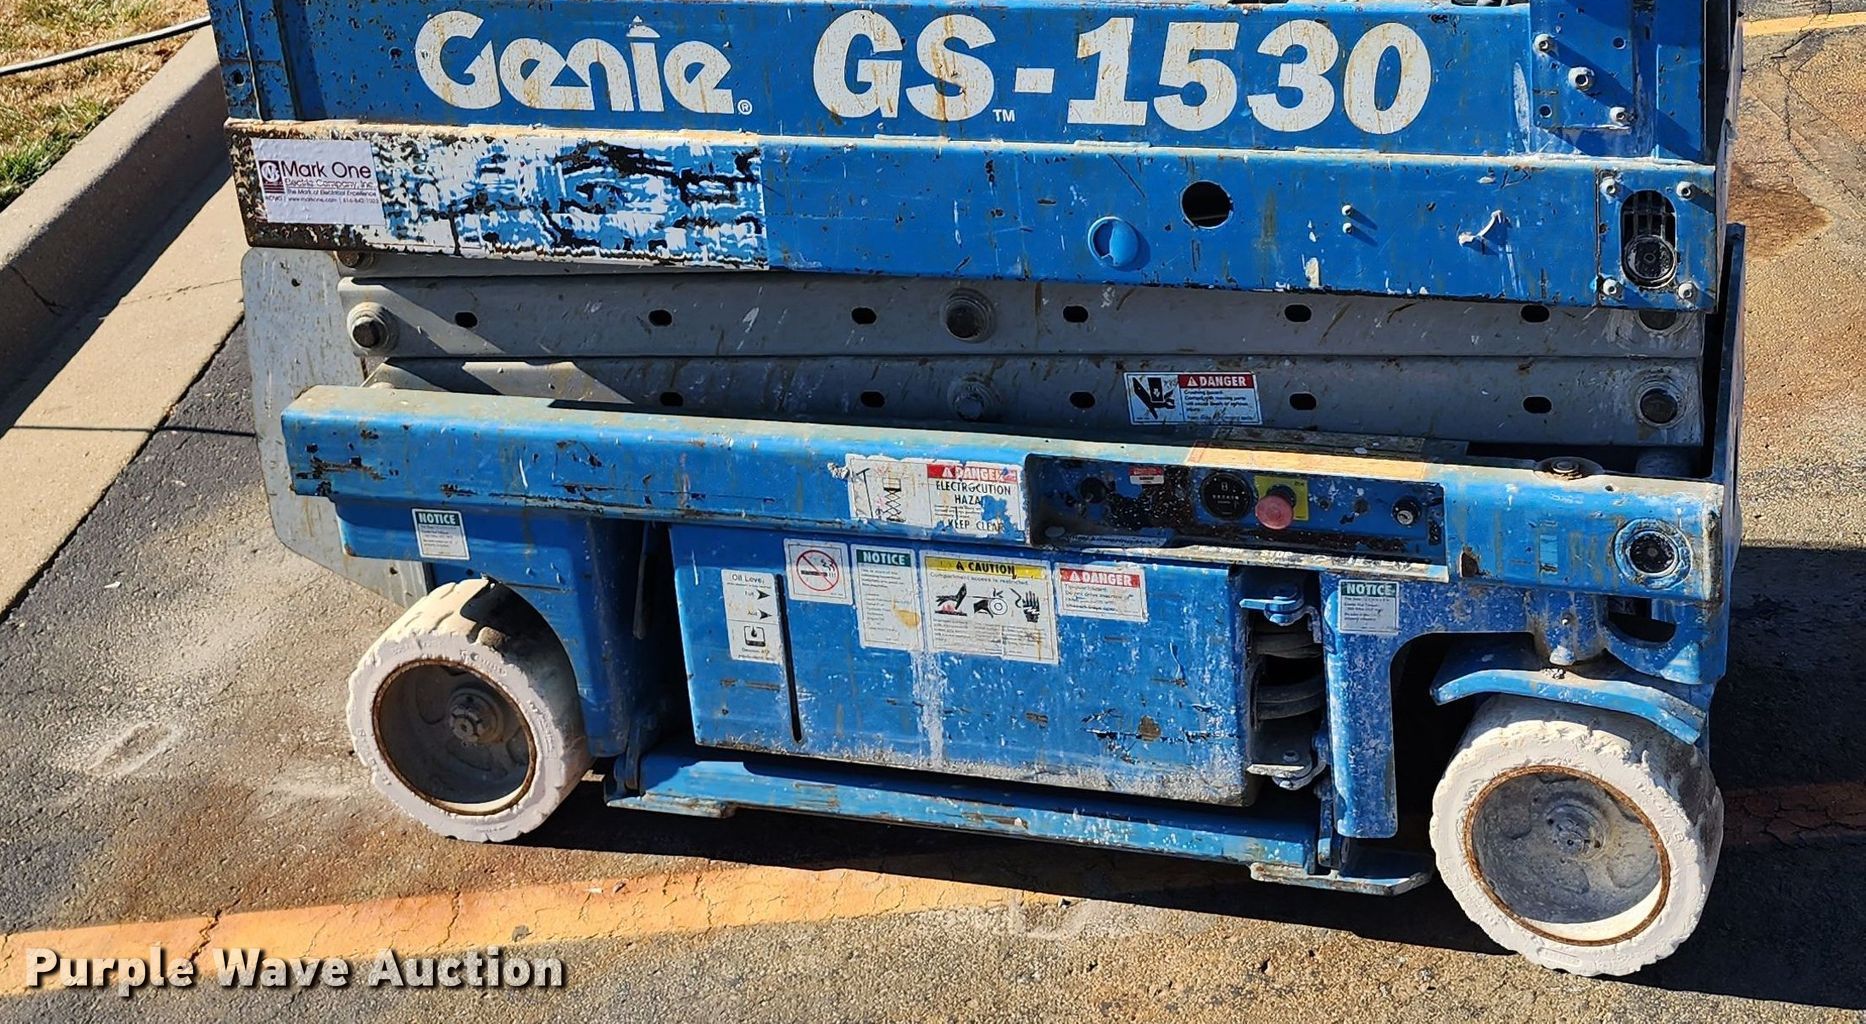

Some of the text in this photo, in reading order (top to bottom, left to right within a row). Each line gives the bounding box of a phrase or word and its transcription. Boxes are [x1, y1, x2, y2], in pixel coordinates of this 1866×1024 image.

[414, 11, 735, 115] Genie
[814, 10, 1433, 134] GS-1530
[281, 160, 371, 179] Mark One
[1200, 376, 1247, 387] DANGER
[935, 480, 1011, 495] ELECTROCUTION
[955, 493, 984, 505] HAZA
[418, 512, 456, 525] NOTICE
[947, 518, 970, 529] KEEP
[862, 551, 905, 565] NOTICE
[968, 562, 1016, 576] CAUTION
[732, 573, 743, 582] Oil
[1082, 571, 1132, 586] DANGER
[1346, 583, 1393, 596] NOTICE
